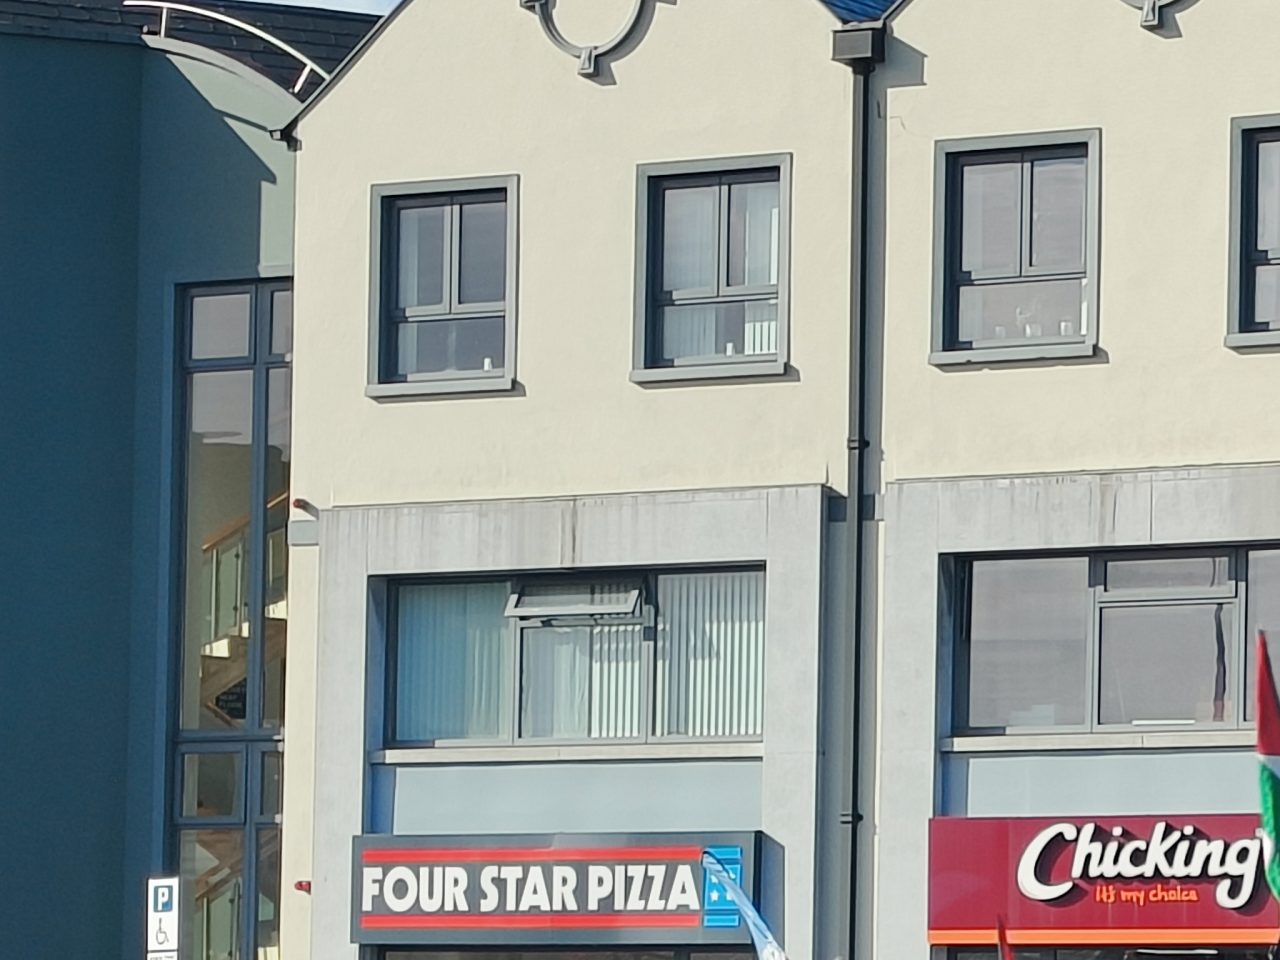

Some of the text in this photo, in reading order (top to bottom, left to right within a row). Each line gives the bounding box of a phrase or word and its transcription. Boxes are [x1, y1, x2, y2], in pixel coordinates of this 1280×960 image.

[1017, 821, 1261, 909] Chicking
[158, 887, 169, 911] P
[361, 864, 701, 913] FOUR STAR PIZZA
[1121, 888, 1145, 906] my
[1149, 884, 1198, 902] choice
